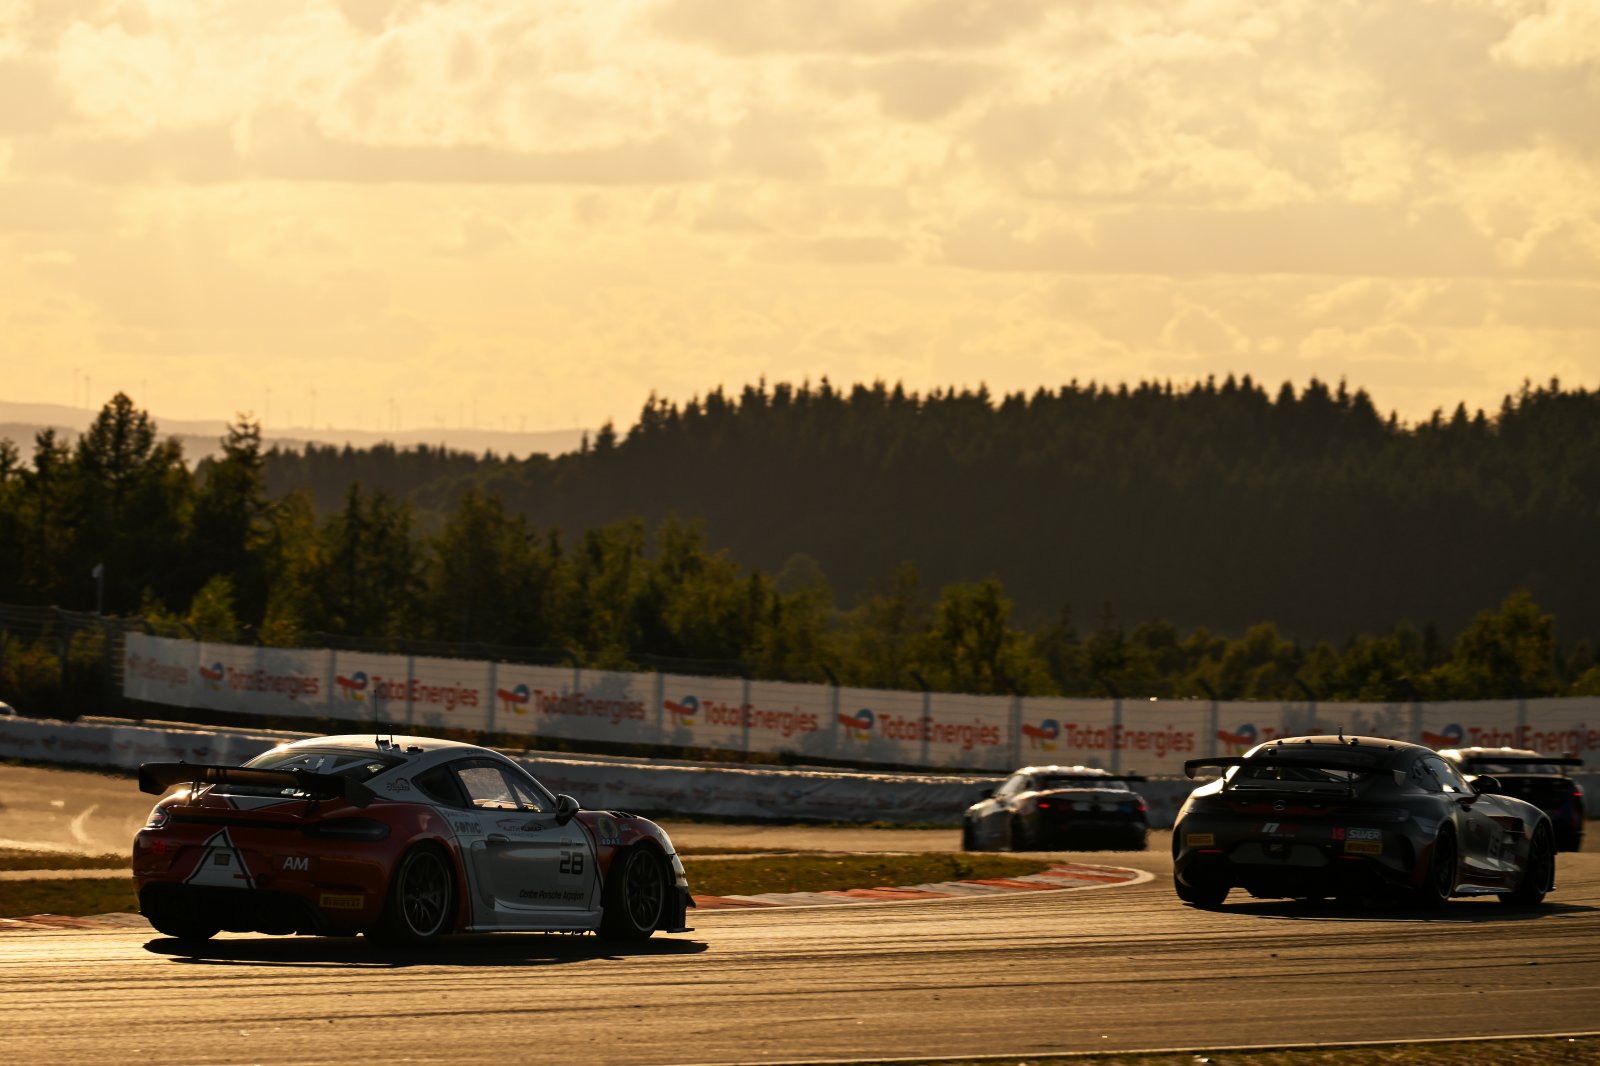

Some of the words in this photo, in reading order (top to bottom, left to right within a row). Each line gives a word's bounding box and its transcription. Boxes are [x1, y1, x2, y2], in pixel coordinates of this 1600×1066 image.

[226, 667, 319, 701] TotalEnergies
[371, 675, 479, 710] TotalEnergies
[533, 688, 645, 725] TotalEnergies
[702, 699, 819, 736] TotalEnergies
[878, 713, 1001, 750] TotalEnergies
[1064, 722, 1195, 757] TotalEnergies
[1468, 722, 1600, 758] TotalEnergie
[282, 856, 309, 872] AM
[560, 851, 584, 875] 28
